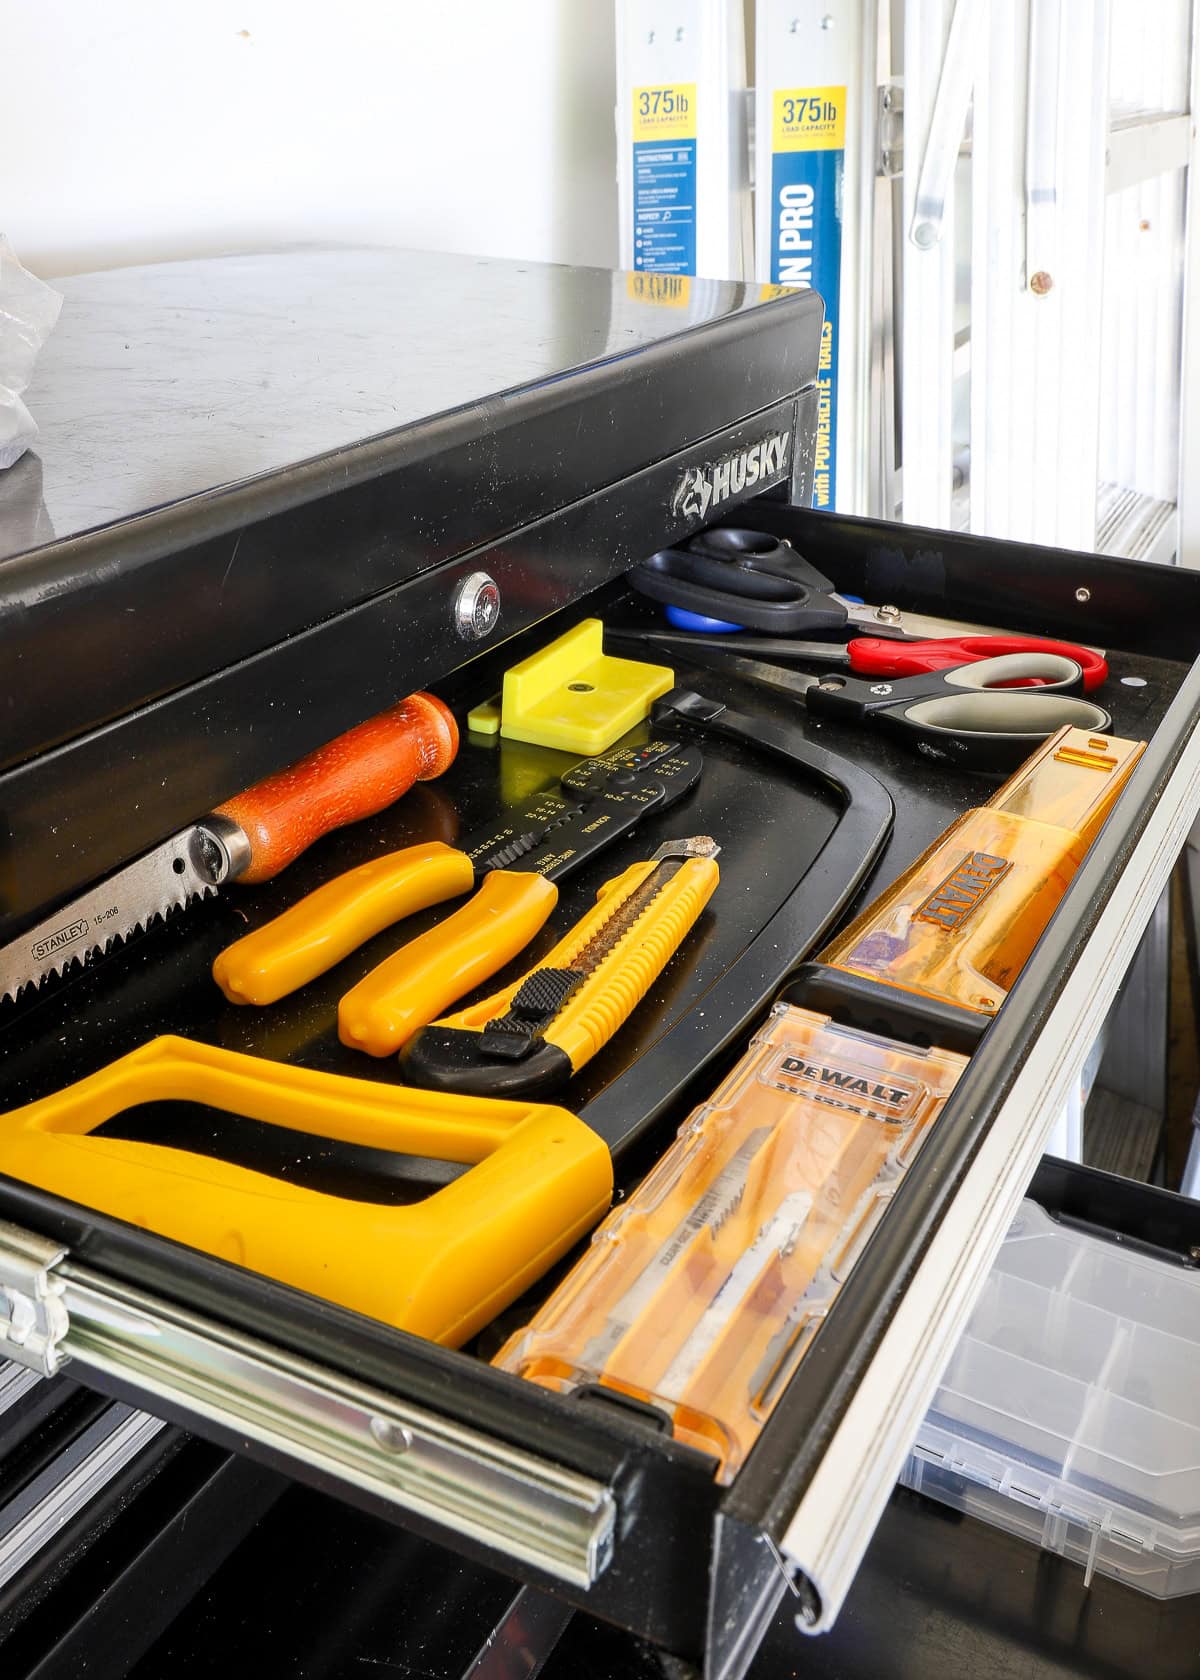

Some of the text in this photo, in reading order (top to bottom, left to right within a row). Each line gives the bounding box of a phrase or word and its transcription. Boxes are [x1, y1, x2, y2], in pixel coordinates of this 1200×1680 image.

[801, 123, 836, 132] CAPACITY
[778, 183, 814, 251] PRO
[712, 431, 790, 506] HUSKY
[36, 906, 119, 957] STANLEY 15-206
